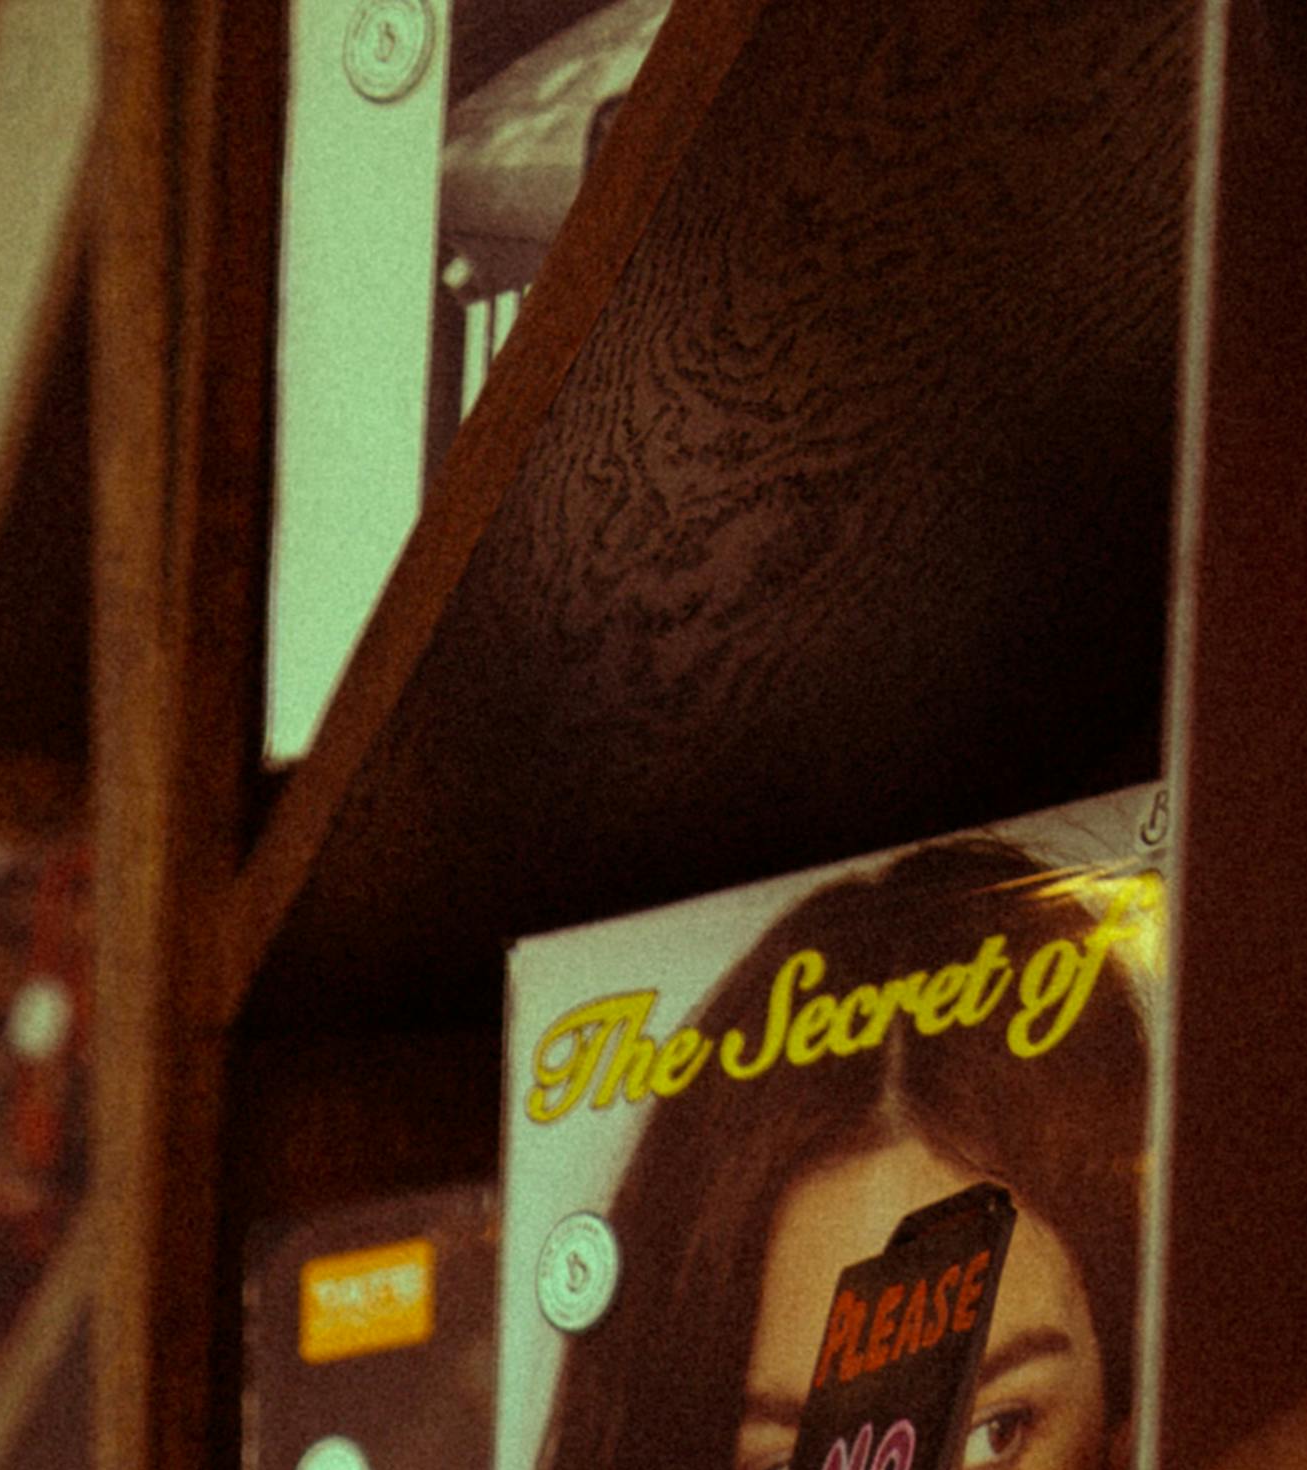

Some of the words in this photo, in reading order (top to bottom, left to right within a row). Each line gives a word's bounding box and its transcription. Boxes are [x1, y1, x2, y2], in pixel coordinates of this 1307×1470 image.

[524, 988, 712, 1125] The
[721, 934, 1014, 1080] Secret
[1006, 868, 1164, 1059] of
[814, 1249, 991, 1388] PLEASE
